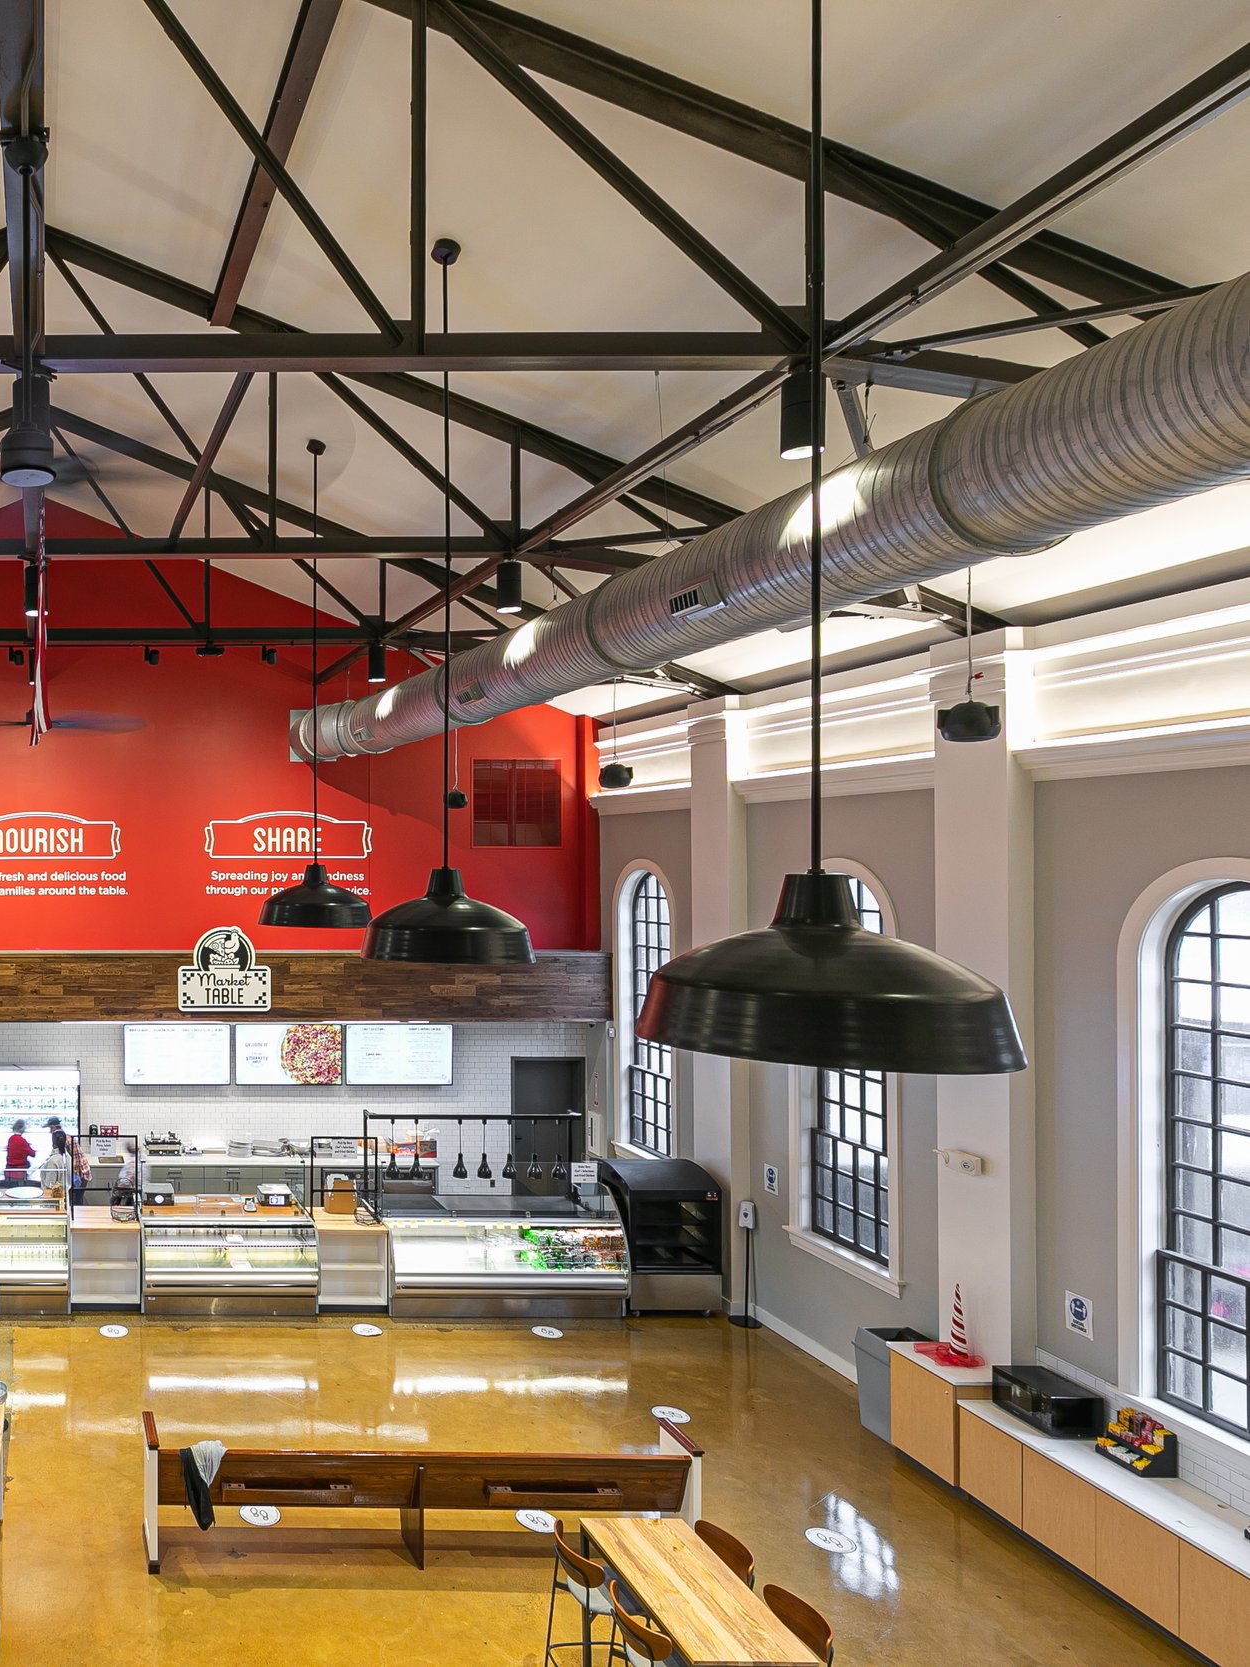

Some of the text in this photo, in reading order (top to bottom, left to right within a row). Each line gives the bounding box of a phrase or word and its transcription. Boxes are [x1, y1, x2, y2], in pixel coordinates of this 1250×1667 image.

[253, 827, 322, 852] SHARE
[27, 871, 48, 881] and
[50, 871, 99, 881] delicious
[101, 871, 126, 881] food
[211, 870, 269, 882] Spreading
[271, 871, 289, 882] joy
[327, 871, 365, 881] ndness
[38, 885, 76, 896] around
[78, 885, 97, 895] the
[98, 885, 129, 895] table.
[205, 884, 248, 897] through
[250, 887, 269, 895] our
[197, 973, 252, 987] Market
[205, 987, 244, 1005] TABLE
